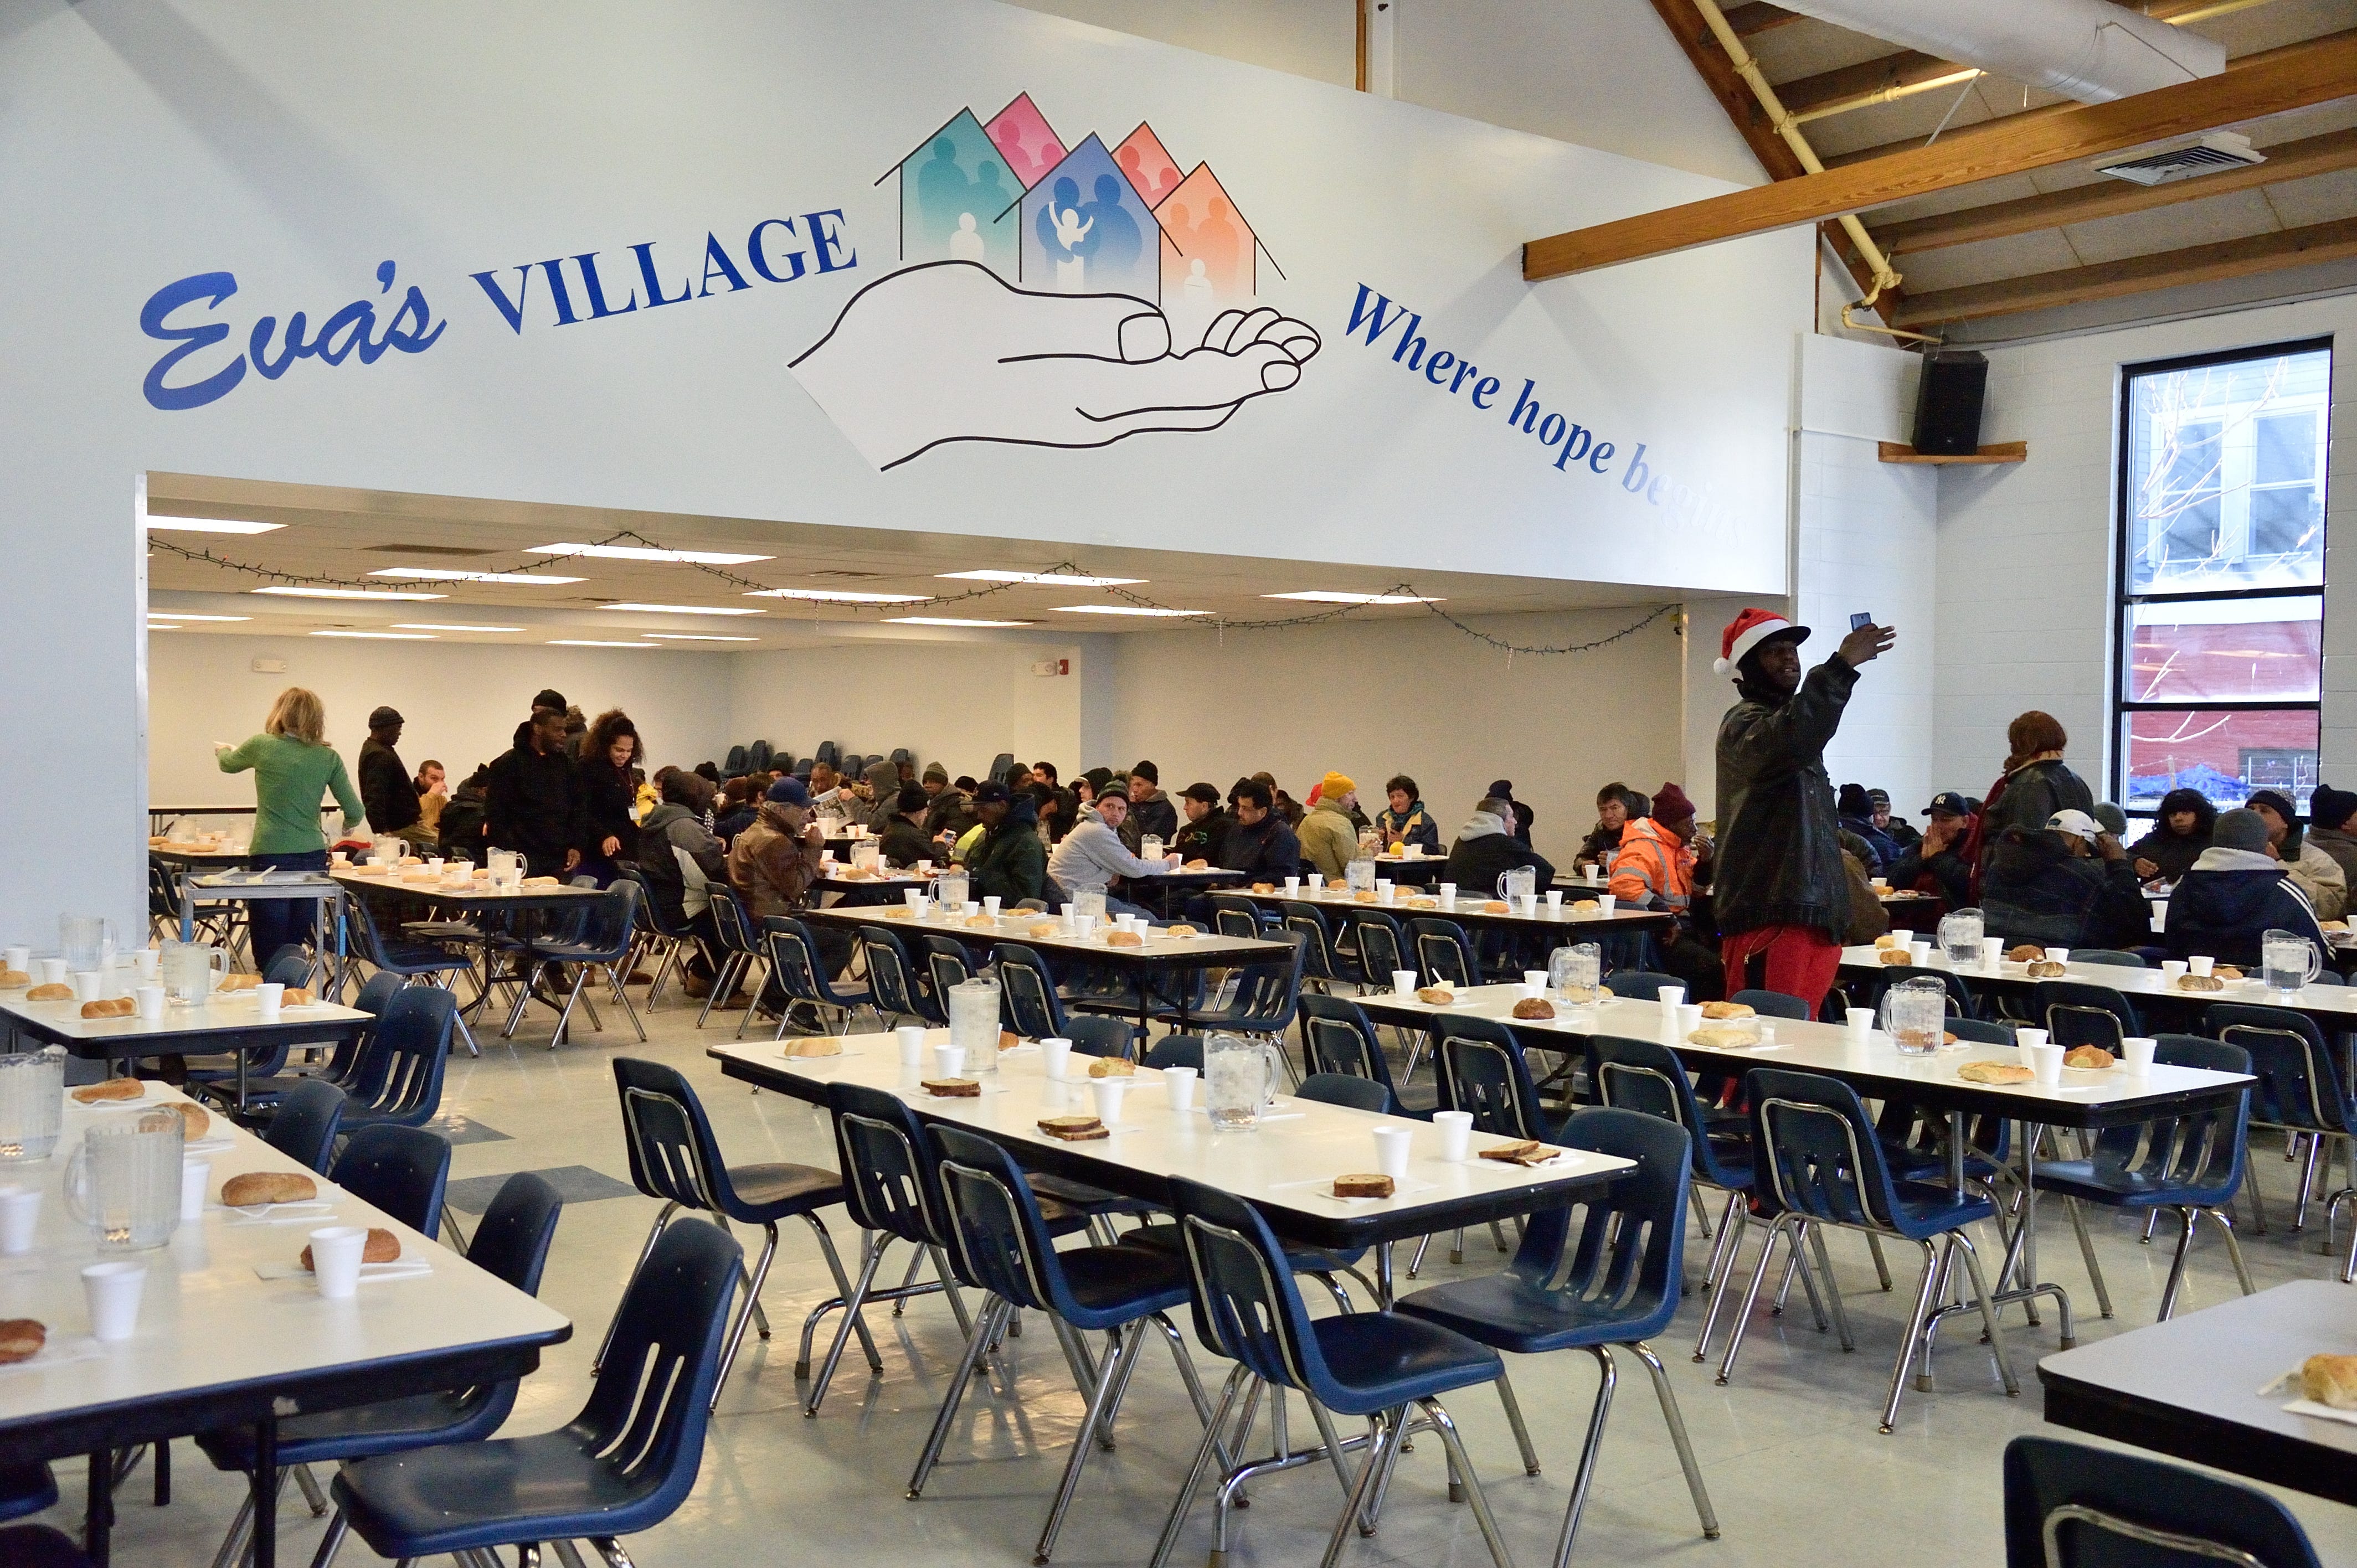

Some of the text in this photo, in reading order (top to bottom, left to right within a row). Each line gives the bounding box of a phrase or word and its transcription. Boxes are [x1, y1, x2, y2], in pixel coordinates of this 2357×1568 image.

[140, 208, 857, 411] Eva's VILLAGE
[1345, 282, 1500, 410] Where
[1507, 379, 1615, 473] hope
